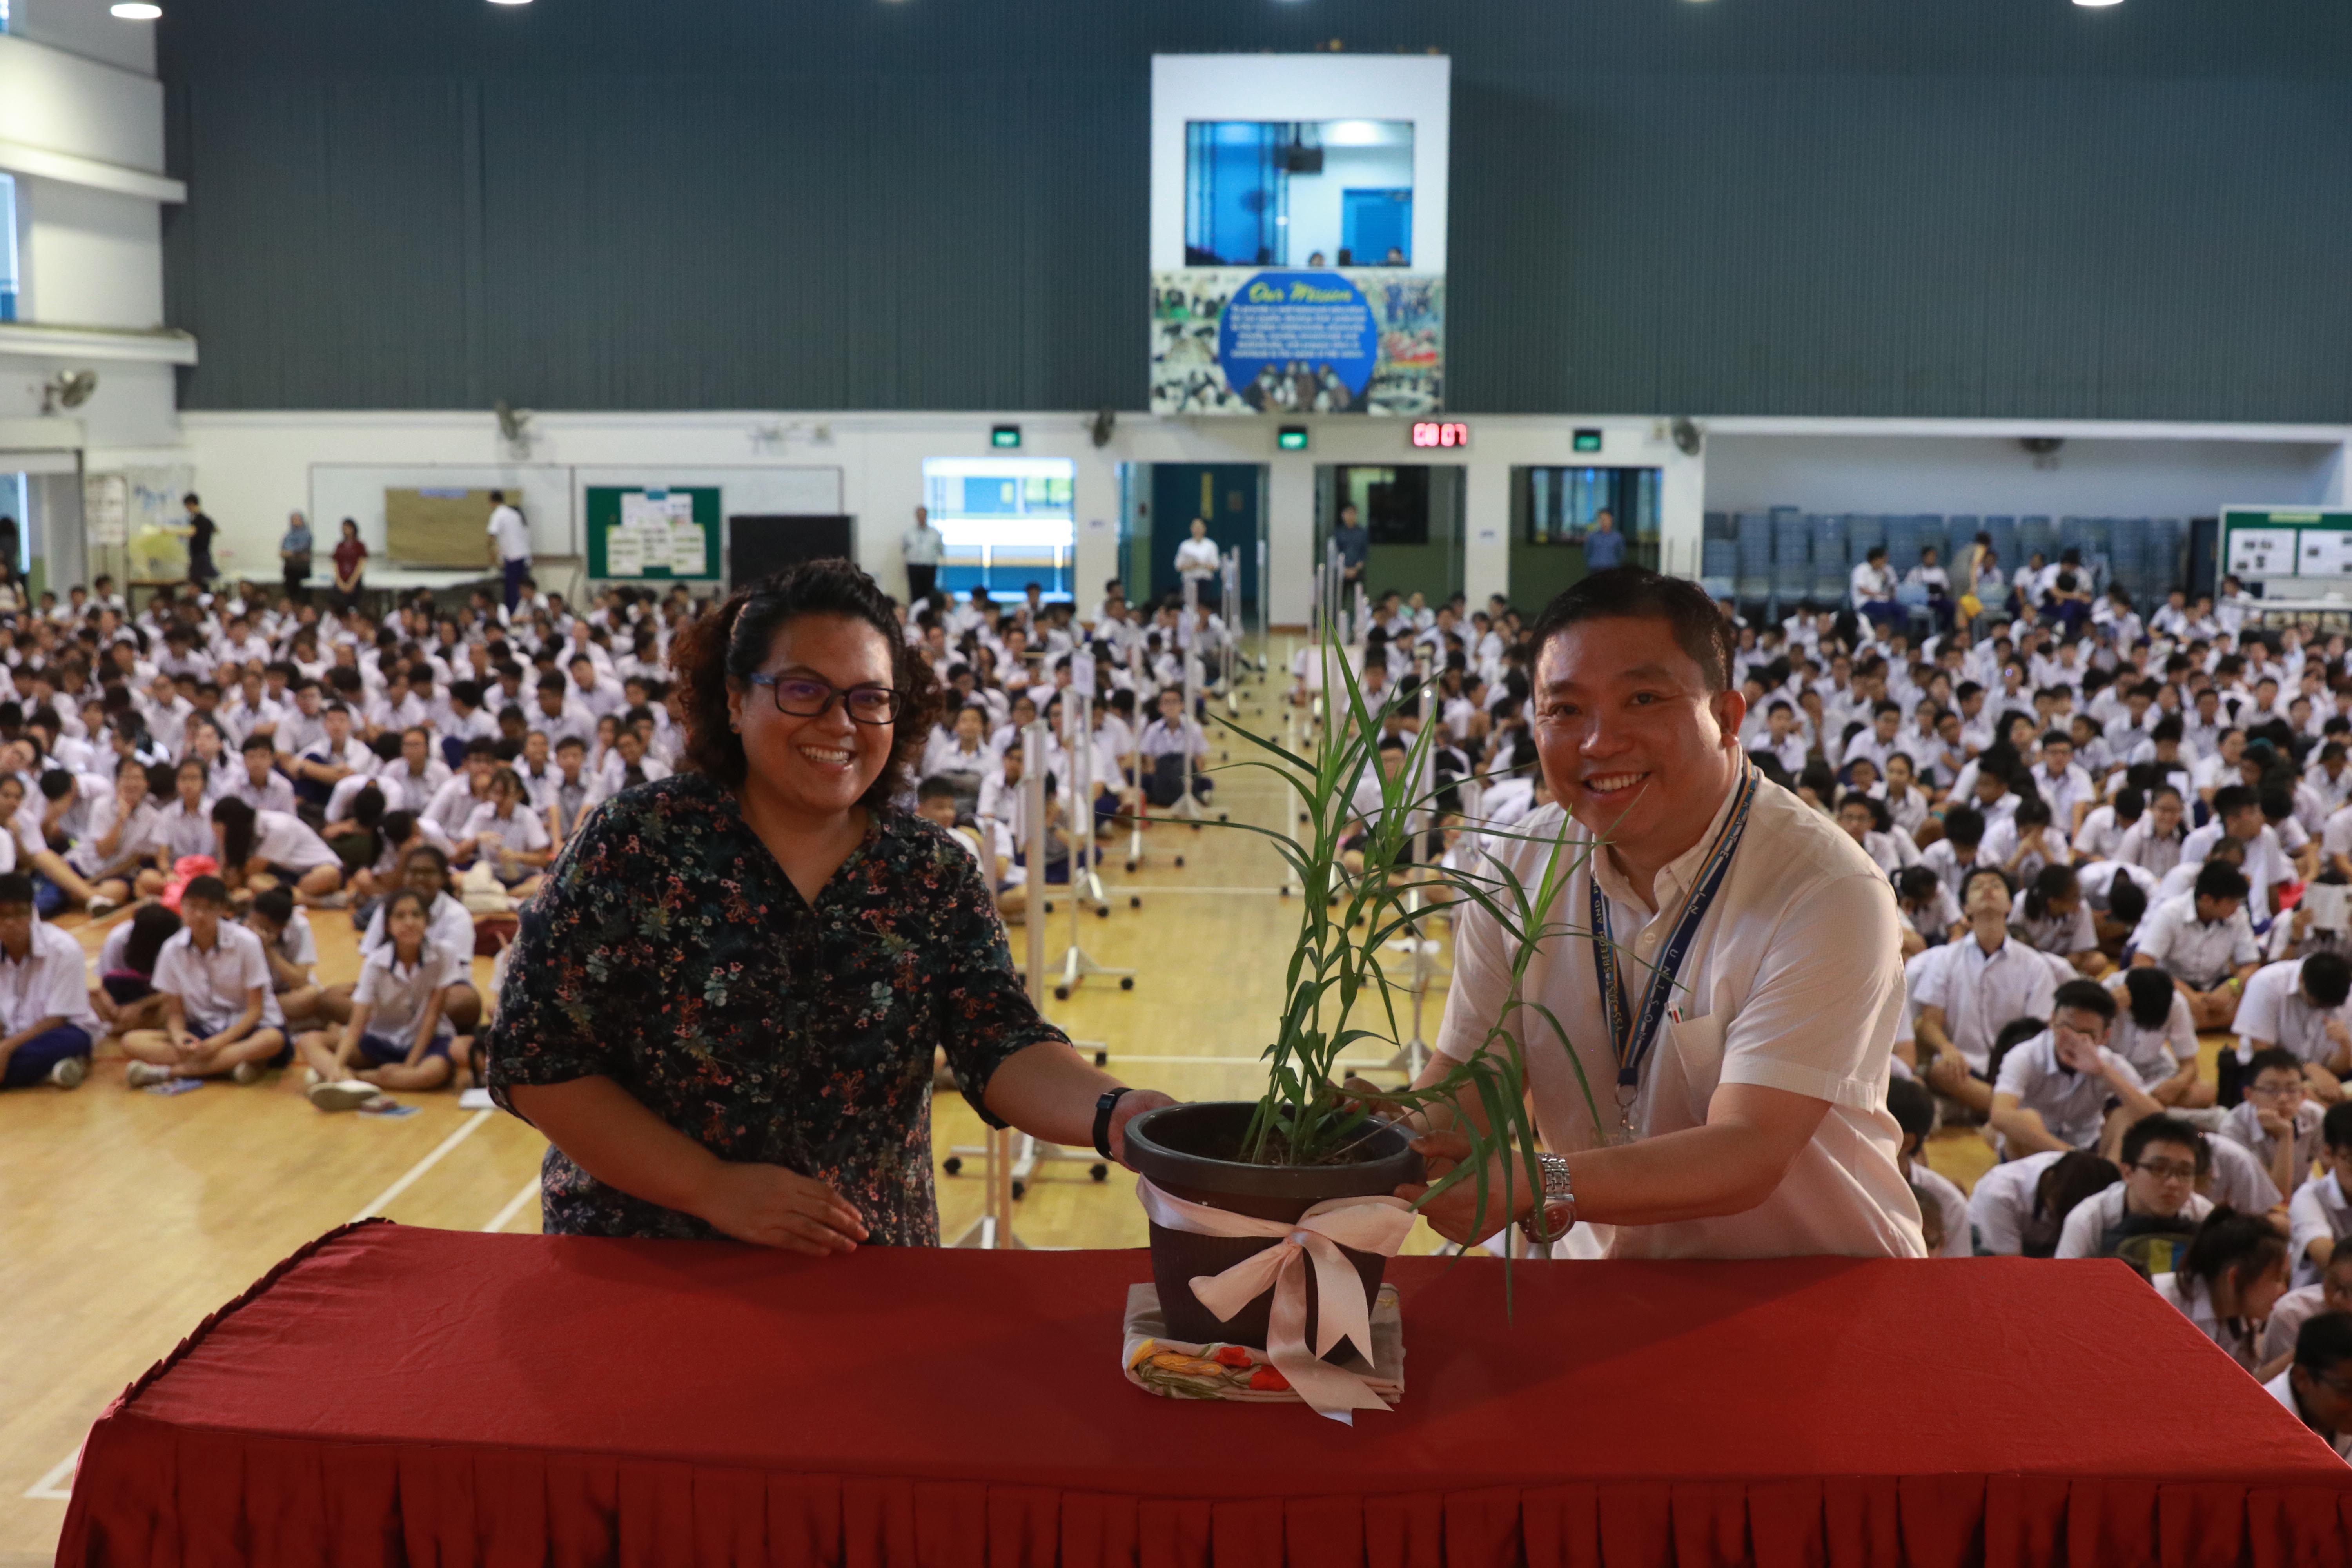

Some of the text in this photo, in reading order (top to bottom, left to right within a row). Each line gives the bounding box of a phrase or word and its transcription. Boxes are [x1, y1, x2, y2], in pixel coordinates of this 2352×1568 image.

[1249, 282, 1285, 303] Our
[1594, 900, 1603, 924] AND
[1688, 889, 1706, 915] IN
[1638, 948, 1678, 1041] UNISON
[1612, 1011, 1624, 1032] YSS
